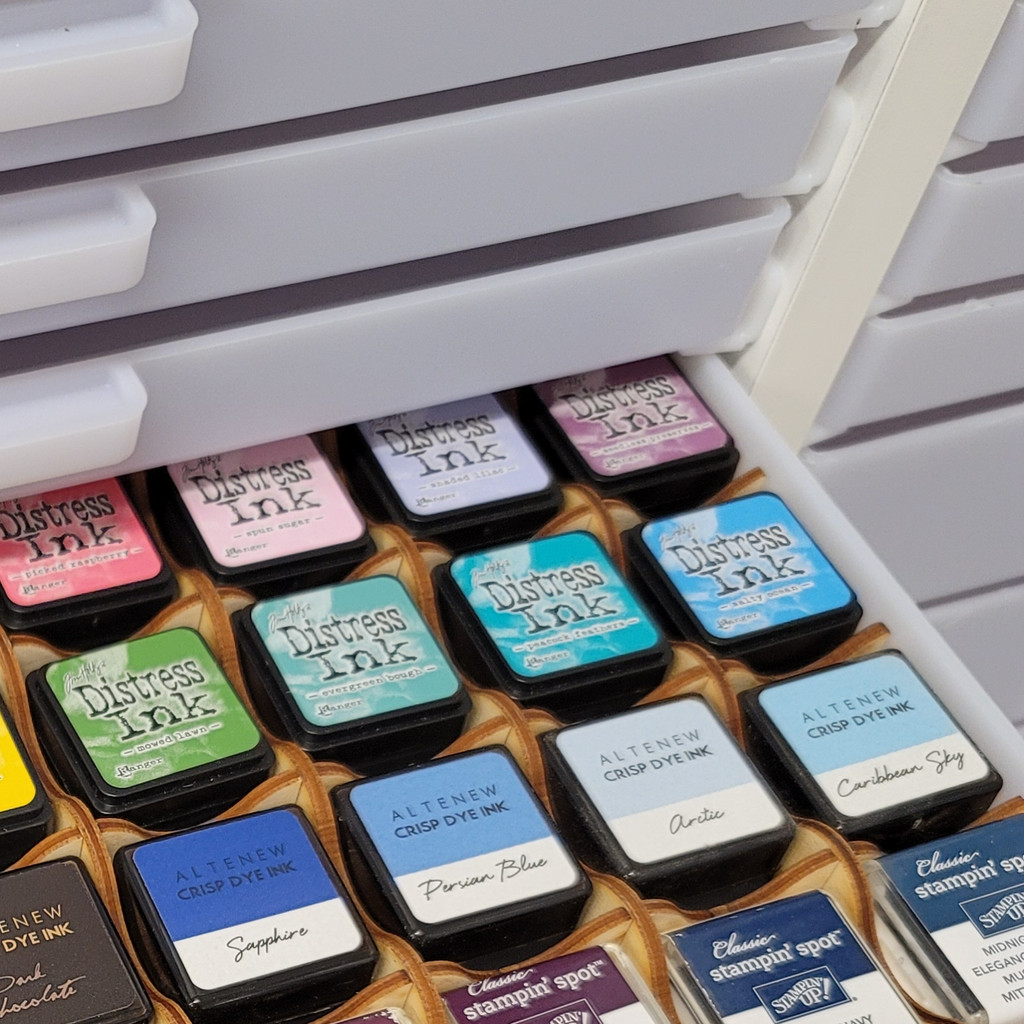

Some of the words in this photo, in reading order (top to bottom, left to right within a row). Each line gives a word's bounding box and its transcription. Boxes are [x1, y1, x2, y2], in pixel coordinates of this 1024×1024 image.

[559, 376, 676, 420] Distress
[376, 415, 496, 456] Distress
[590, 402, 688, 439] Ink
[405, 440, 507, 477] Ink
[189, 460, 312, 504] Distress
[216, 487, 321, 526] Ink
[16, 522, 123, 562] Ink
[247, 527, 274, 538] spun
[279, 518, 310, 531] sugar
[666, 526, 790, 574] Distress
[480, 565, 603, 611] Distress
[699, 554, 805, 596] Ink
[277, 609, 406, 657] Distress
[511, 593, 617, 633] Ink
[307, 638, 417, 680] Ink
[73, 661, 205, 717] Distress
[322, 678, 383, 696] evergreen
[387, 669, 422, 682] bough
[105, 693, 216, 740] Ink
[138, 736, 172, 751] mowed
[178, 727, 207, 739] lawn
[600, 729, 700, 766] ALTENEW
[603, 763, 648, 782] CRISP
[652, 753, 683, 770] DYE
[686, 745, 714, 760] INK
[837, 765, 923, 797] Caribbean
[925, 750, 965, 774] Sky
[418, 873, 494, 901] Persian
[496, 855, 547, 882] Blue
[2, 933, 40, 953] DYE
[43, 922, 74, 941] INK
[227, 927, 308, 963] Sapphire
